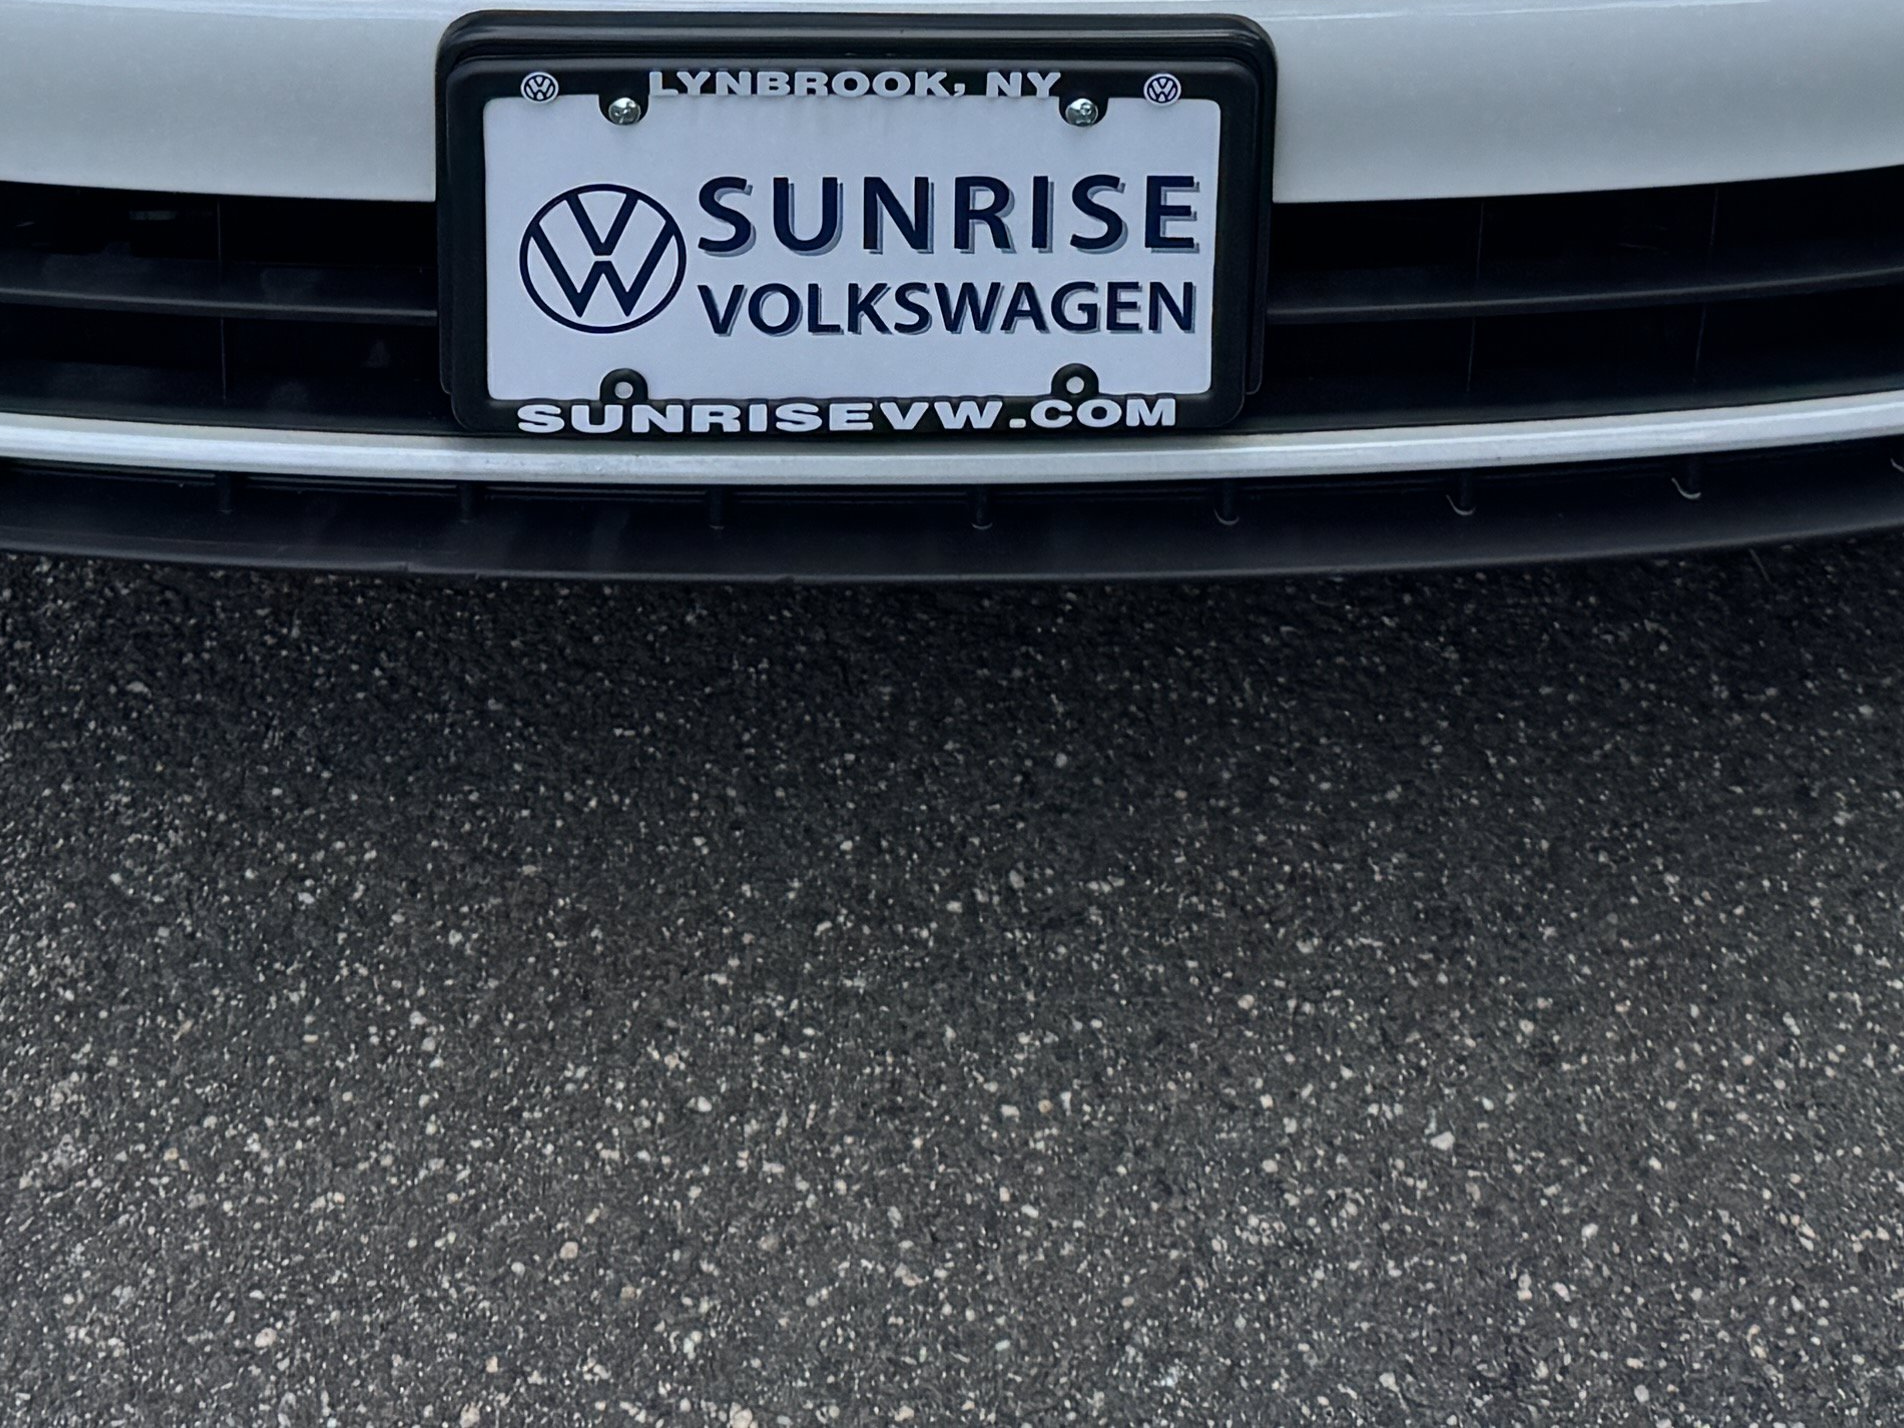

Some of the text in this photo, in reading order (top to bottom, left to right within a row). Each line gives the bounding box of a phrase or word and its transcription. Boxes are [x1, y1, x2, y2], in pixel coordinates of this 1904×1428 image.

[648, 70, 1062, 98] LYNBROOK, NY
[697, 174, 1199, 254] SUNRISE
[697, 280, 1197, 336] VOLKSWAGEN
[517, 398, 1177, 433] SUNRISEVW.COM
